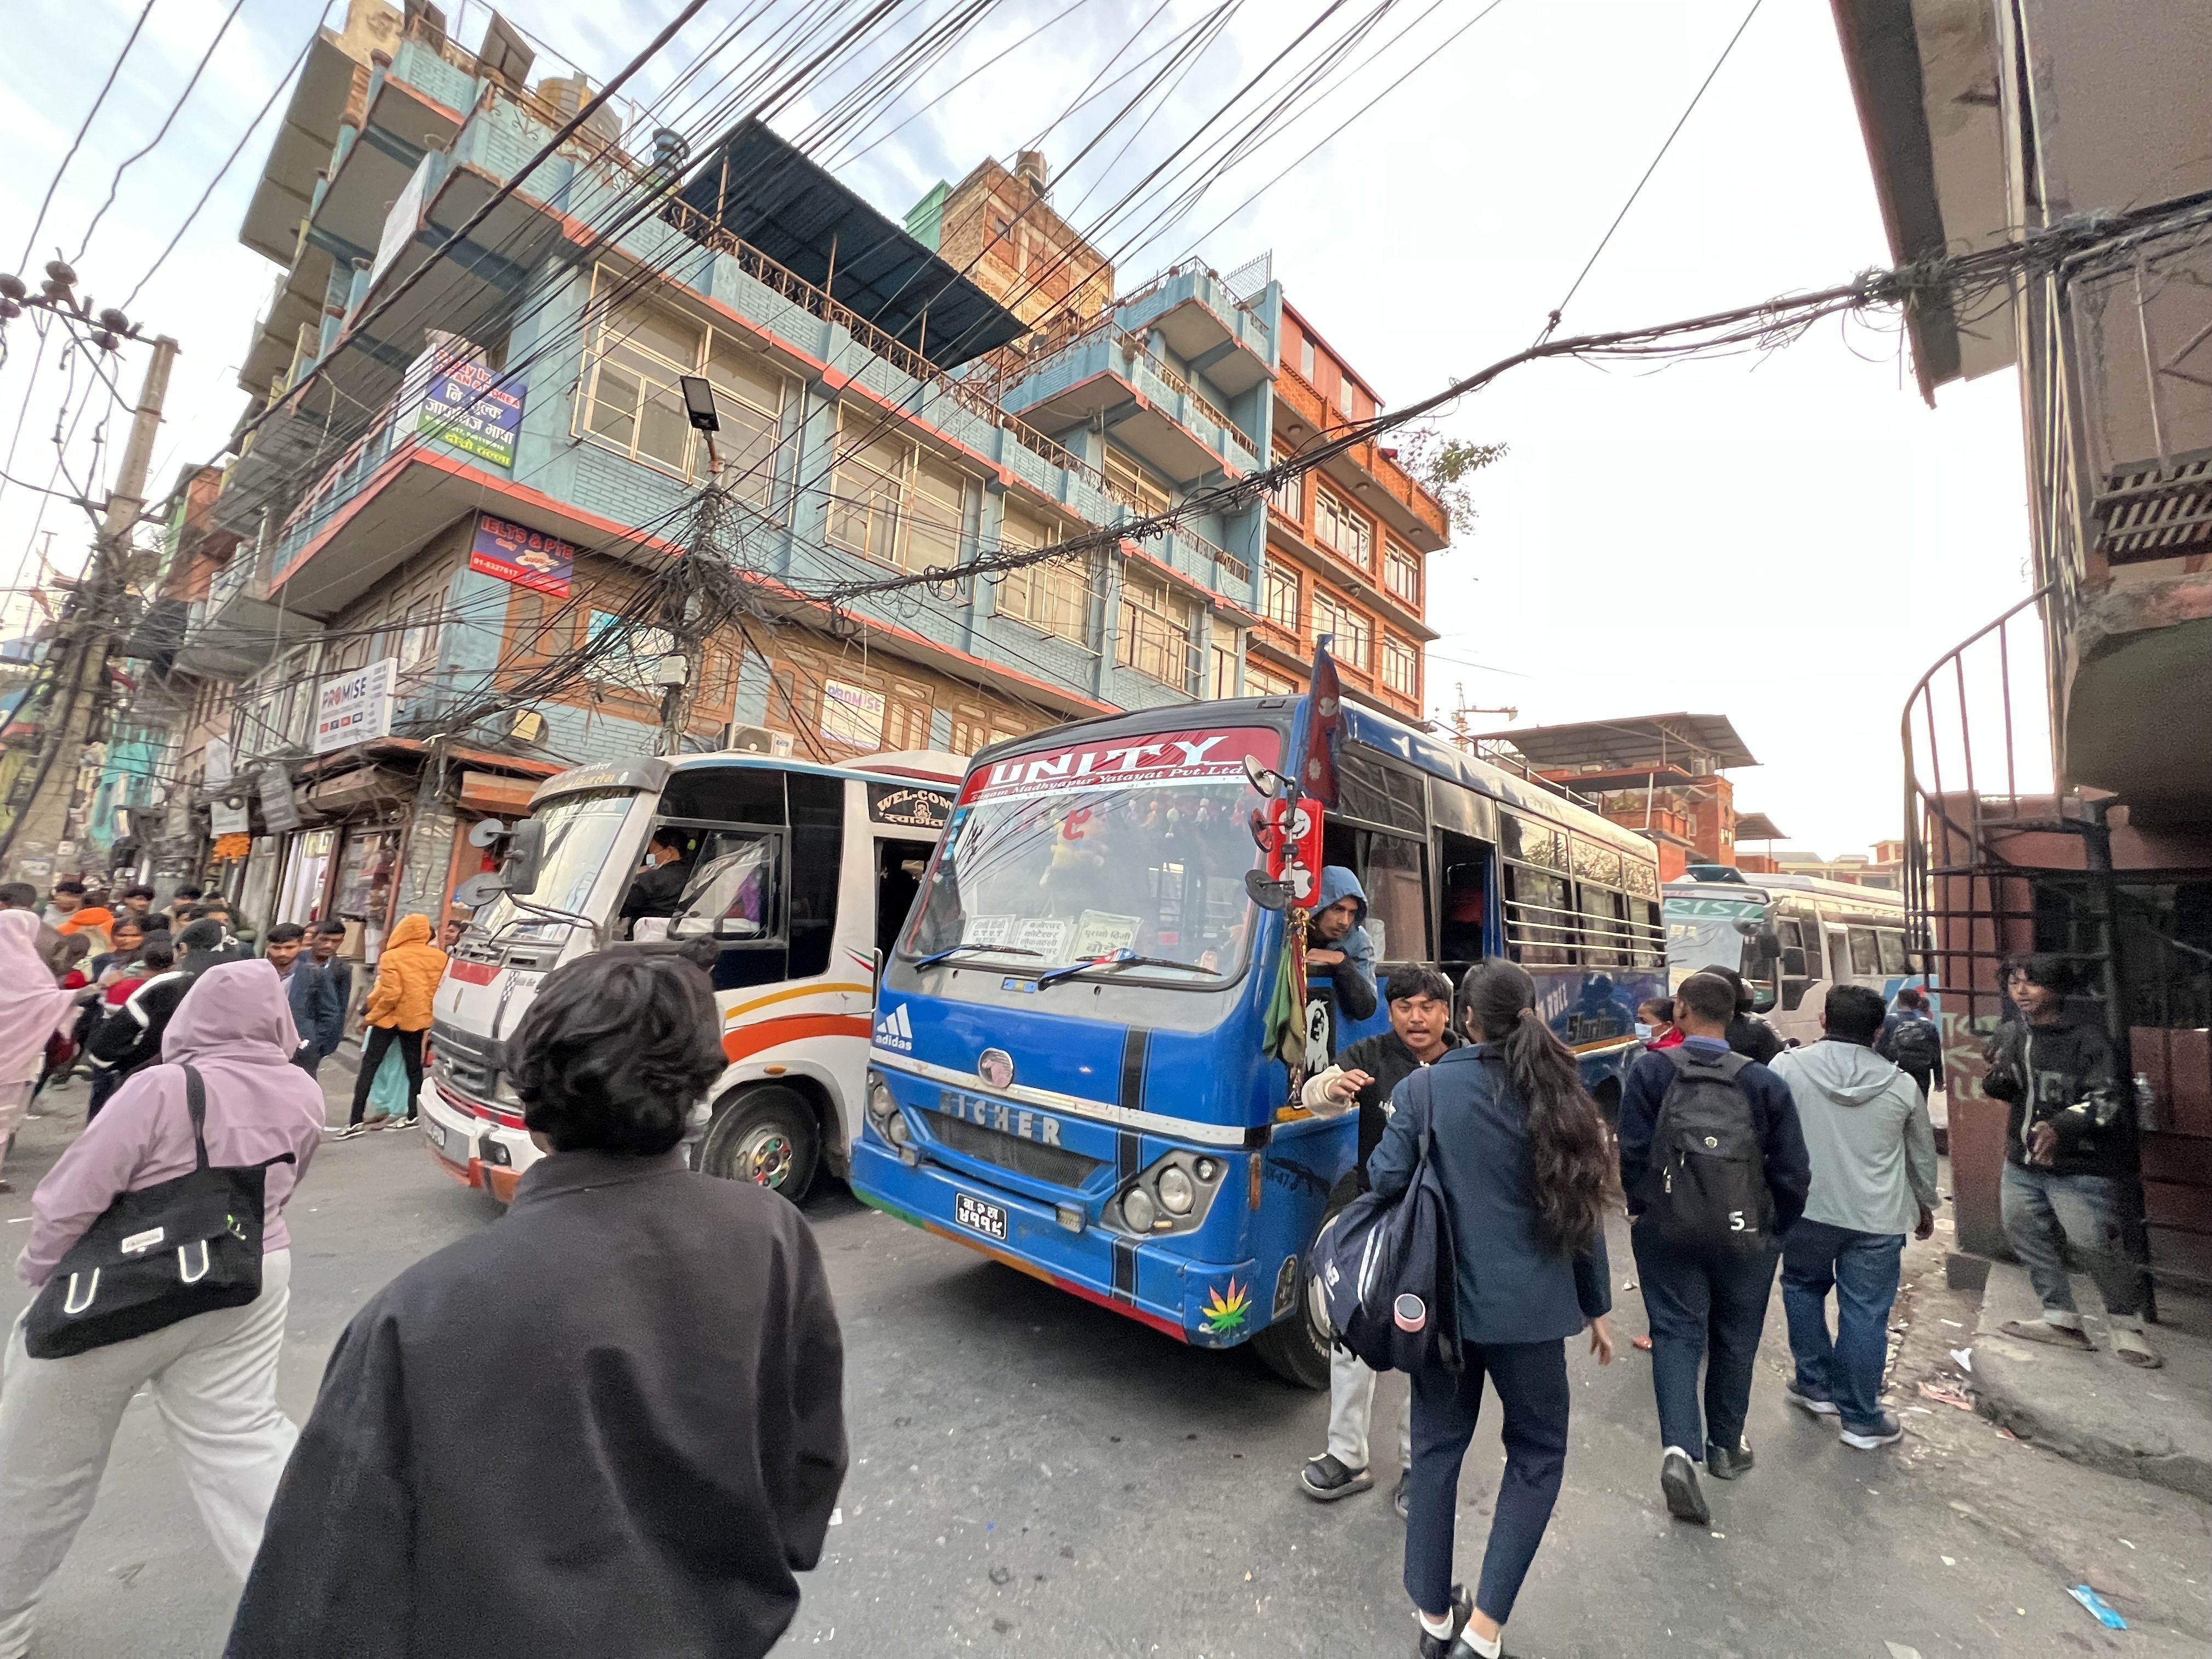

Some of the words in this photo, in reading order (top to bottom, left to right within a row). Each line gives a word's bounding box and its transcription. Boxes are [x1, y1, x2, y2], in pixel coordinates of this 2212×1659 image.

[481, 515, 527, 543] IELTS
[529, 533, 541, 549] &
[544, 538, 575, 560] PTE
[322, 676, 367, 709] PROMISE
[827, 685, 881, 712] PROMISE
[990, 736, 1229, 785] UNITY
[877, 789, 953, 811] WEL-COM
[970, 789, 1008, 802] Sugam
[1011, 776, 1095, 794] Madhyapur
[1099, 770, 1164, 783] Yatayat
[884, 814, 946, 827] स्वागत
[1663, 898, 1754, 917] RIST
[875, 1034, 912, 1051] adidas
[939, 1088, 1061, 1146] EICHER
